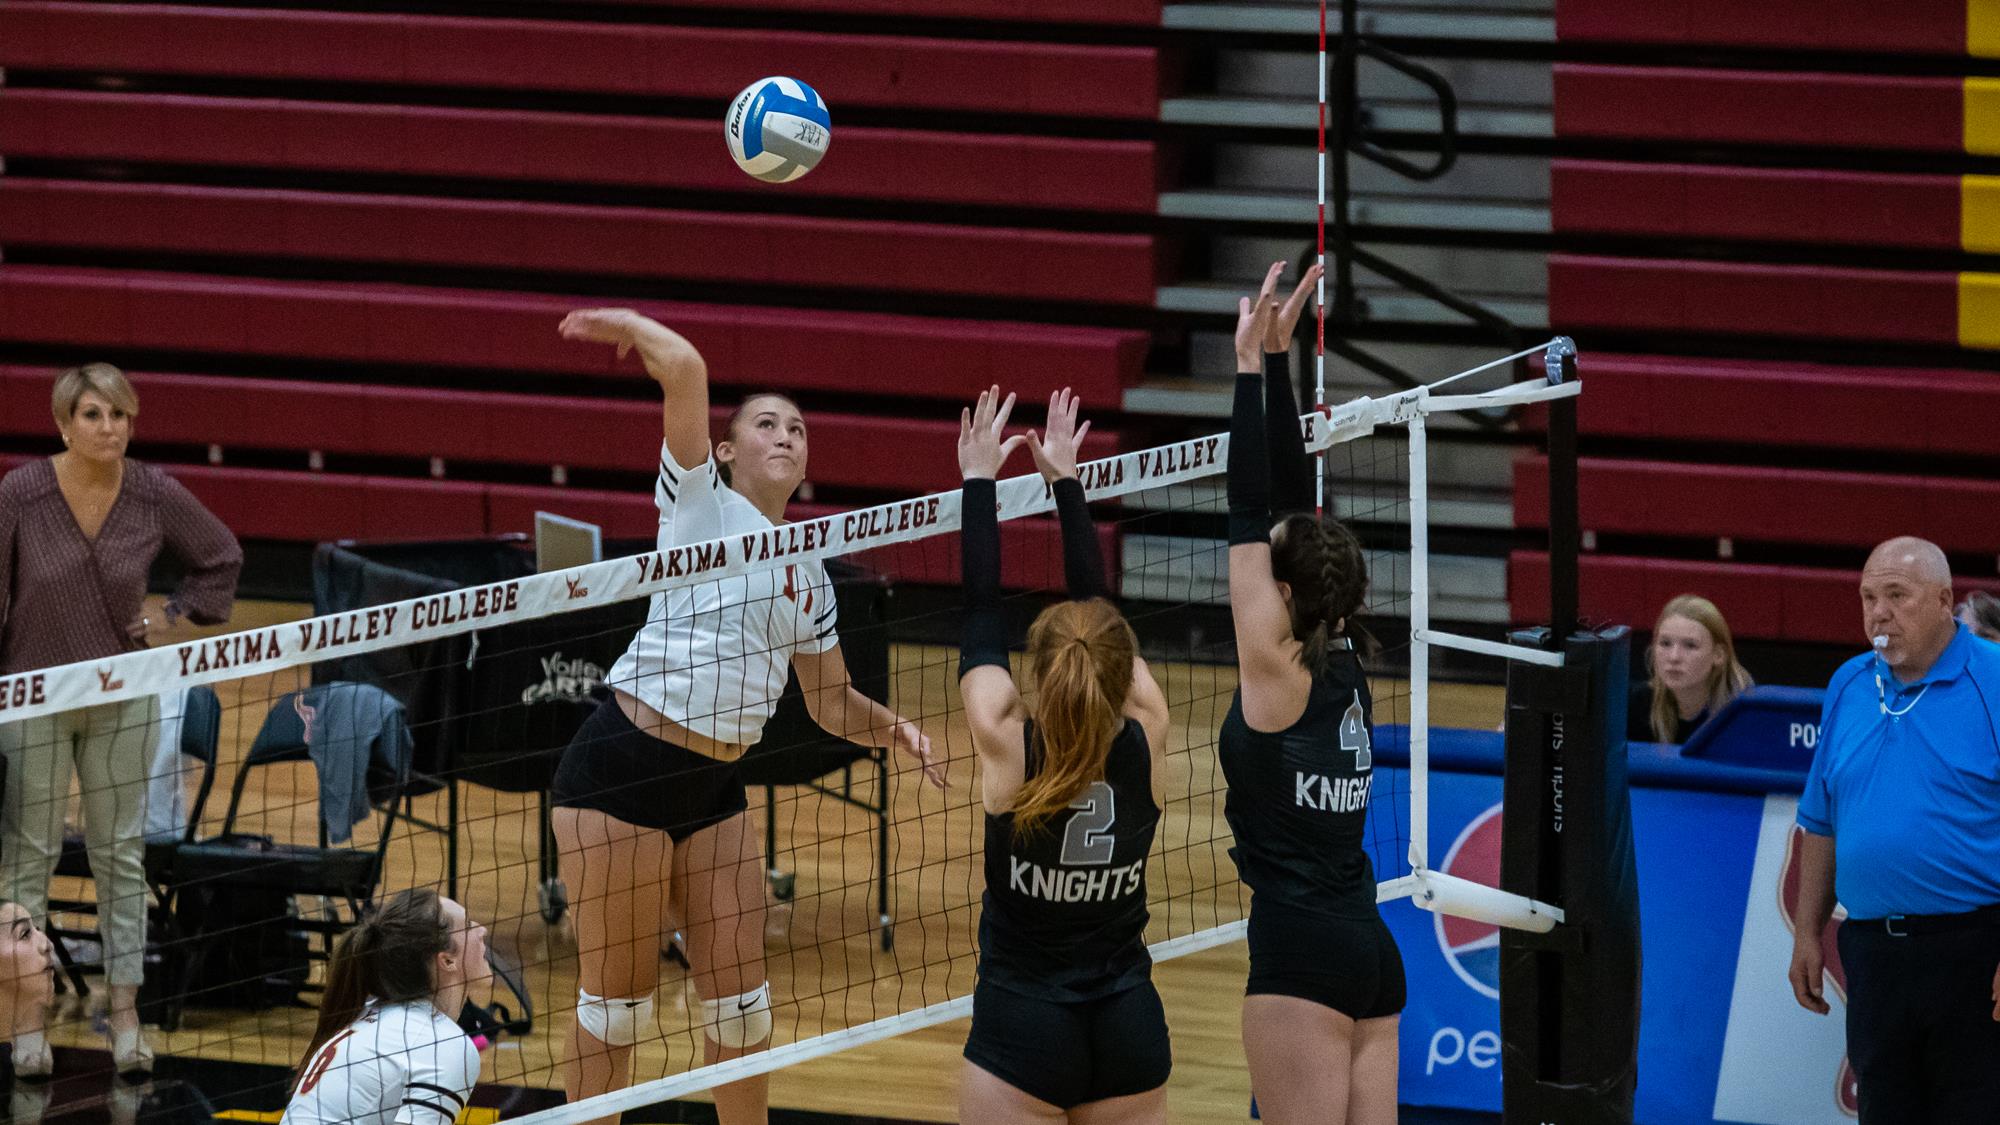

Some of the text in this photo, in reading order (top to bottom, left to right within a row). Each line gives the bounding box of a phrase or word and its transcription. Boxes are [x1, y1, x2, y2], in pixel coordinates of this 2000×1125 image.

[1138, 438, 1219, 479] VALLEY
[636, 497, 940, 584] YAKIMA VALLEY COLLEGE
[179, 582, 519, 676] YAKIMA VALLEY COLLEGE
[1340, 688, 1371, 771] 4
[1790, 723, 1821, 748] PO
[1060, 781, 1115, 865] 2
[1010, 854, 1143, 903] KNIGHTS
[1426, 1026, 1501, 1075] pe
